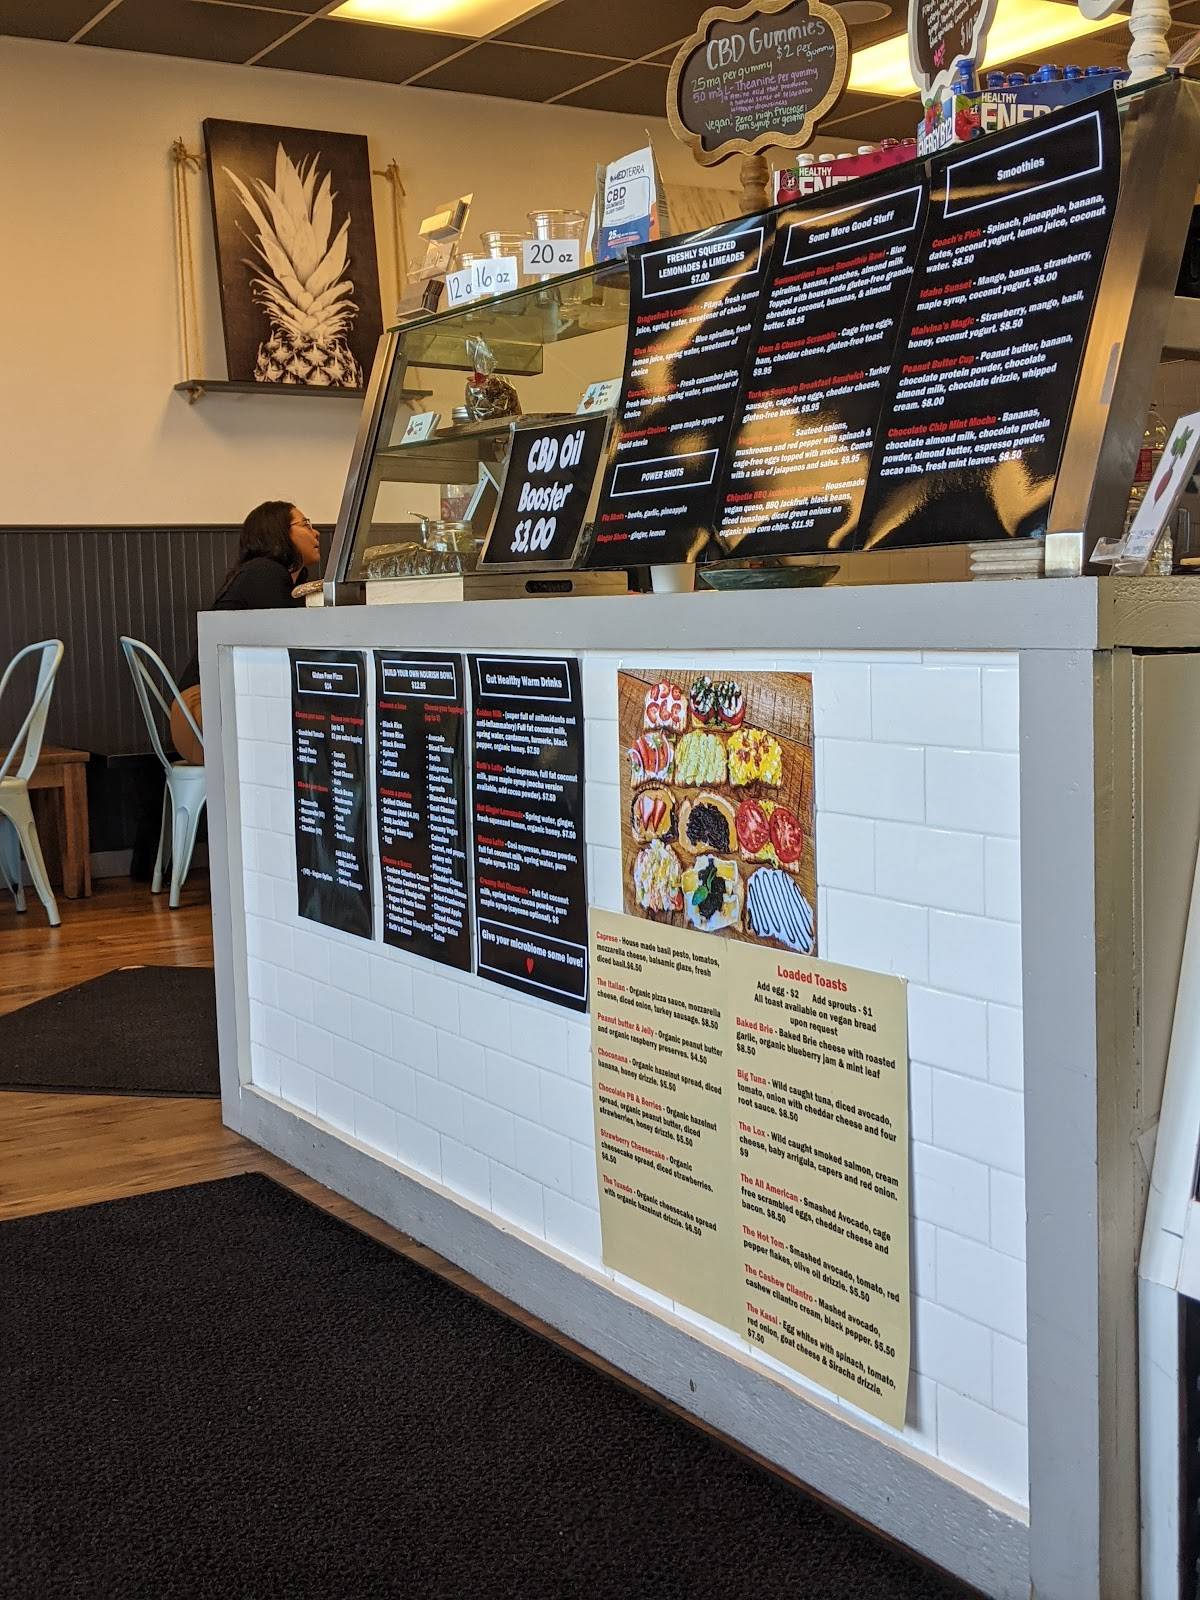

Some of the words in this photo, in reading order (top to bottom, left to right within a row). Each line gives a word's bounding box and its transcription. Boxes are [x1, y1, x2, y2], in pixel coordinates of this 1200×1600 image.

[707, 35, 745, 70] CBD
[750, 20, 825, 54] Gummies
[777, 44, 793, 60] $2
[797, 42, 812, 56] per
[807, 44, 834, 62] gummy
[738, 61, 772, 79] gummy
[778, 73, 790, 84] per
[791, 68, 818, 80] gummy
[981, 92, 1017, 103] HEALTHY
[800, 167, 832, 178] HEALTHY
[997, 158, 1044, 181] Smoothies
[606, 186, 626, 203] CBD
[808, 231, 830, 243] Some
[830, 225, 850, 237] More
[851, 217, 872, 231] Good
[873, 211, 894, 225] Stuff
[964, 228, 981, 241] Pick
[987, 217, 1021, 234] Spinach,
[1022, 204, 1066, 225] pineapple,
[1068, 194, 1104, 210] banana,
[929, 249, 953, 260] dates,
[954, 238, 987, 254] coconut
[987, 231, 1016, 248] yogurt,
[1017, 225, 1043, 238] lemon
[1044, 218, 1068, 233] juice,
[1070, 205, 1106, 223] coconut
[530, 244, 554, 264] 20
[558, 253, 574, 263] oz
[659, 261, 700, 278] LEMONADES
[702, 259, 708, 269] &
[709, 251, 744, 267] LIMEADES
[667, 248, 697, 264] FRESHLY
[698, 240, 736, 256] SQUEEZED
[448, 277, 462, 301] 12
[466, 282, 472, 294] o
[476, 266, 492, 287] 16
[496, 272, 510, 283] oz
[691, 272, 710, 285] $7.00
[769, 296, 793, 308] Topped
[793, 292, 807, 303] with
[808, 283, 846, 299] housemade
[846, 274, 885, 291] gluten-free
[885, 266, 914, 281] granola,
[916, 299, 942, 311] maple
[943, 295, 967, 307] syrup,
[968, 285, 1002, 300] coconut
[1002, 278, 1031, 294] yogurt.
[1033, 271, 1058, 286] $8.00
[899, 373, 938, 386] chocolate
[938, 367, 969, 382] protein
[970, 362, 1003, 377] powder,
[1004, 353, 1046, 369] chocolate
[893, 402, 920, 412] cream.
[921, 396, 944, 408] $8.00
[528, 437, 558, 473] CBD
[560, 430, 585, 469] Oil
[641, 470, 663, 482] POWER
[663, 467, 684, 478] SHOTS
[518, 482, 573, 512] Booster
[719, 527, 742, 537] organic
[771, 522, 790, 532] chips.
[791, 519, 814, 529] $11.95
[486, 674, 496, 684] Gut
[498, 675, 520, 688] Healthy
[521, 676, 540, 686] Warm
[540, 676, 562, 688] Drinks
[482, 929, 495, 942] Give
[496, 935, 510, 946] your
[510, 938, 546, 957] microbiome
[547, 950, 565, 962] some
[566, 953, 583, 968] love!
[621, 936, 639, 948] House
[640, 943, 656, 952] made
[656, 944, 671, 955] basil
[672, 950, 691, 961] pesto,
[692, 952, 719, 968] tomatos,
[778, 965, 812, 984] Loaded
[814, 973, 847, 992] Toasts
[597, 989, 618, 1004] cheese,
[619, 995, 634, 1006] diced
[635, 1001, 653, 1012] onion,
[654, 1004, 672, 1018] turkey
[673, 1011, 700, 1025] sausage.
[701, 1017, 718, 1030] $8.50
[754, 993, 763, 1003] All
[764, 996, 783, 1008] toast
[784, 1002, 817, 1017] available
[818, 1011, 828, 1020] on
[829, 1014, 852, 1026] vegan
[854, 1018, 876, 1032] bread
[757, 981, 770, 992] Add
[772, 986, 785, 997] egg
[790, 988, 799, 999] $2
[812, 994, 826, 1005] Add
[828, 1000, 856, 1013] sprouts
[863, 1006, 872, 1017] $1
[790, 1017, 807, 1028] upon
[809, 1022, 838, 1036] request
[736, 1017, 757, 1030] Baked
[759, 1023, 773, 1034] Brie
[779, 1028, 801, 1042] Baked
[802, 1034, 817, 1046] Brie
[818, 1040, 846, 1054] cheese
[847, 1048, 864, 1060] with
[865, 1054, 895, 1069] roasted
[736, 1031, 757, 1045] garlic,
[759, 1038, 786, 1051] organic
[787, 1043, 821, 1063] blueberry
[822, 1053, 836, 1066] jam
[838, 1058, 844, 1069] &
[846, 1062, 863, 1074] mint
[865, 1066, 880, 1079] leaf
[741, 1173, 753, 1184] The
[755, 1178, 764, 1189] All
[766, 1182, 798, 1202] American
[803, 1197, 836, 1218] Smashed
[838, 1211, 871, 1234] Avocado,
[872, 1228, 891, 1241] cage
[747, 1317, 758, 1328] red
[759, 1323, 779, 1340] onion,
[780, 1334, 795, 1348] goat
[796, 1343, 820, 1362] cheese
[822, 1355, 827, 1366] &
[828, 1359, 855, 1381] Siracha
[857, 1375, 882, 1396] drizzle.
